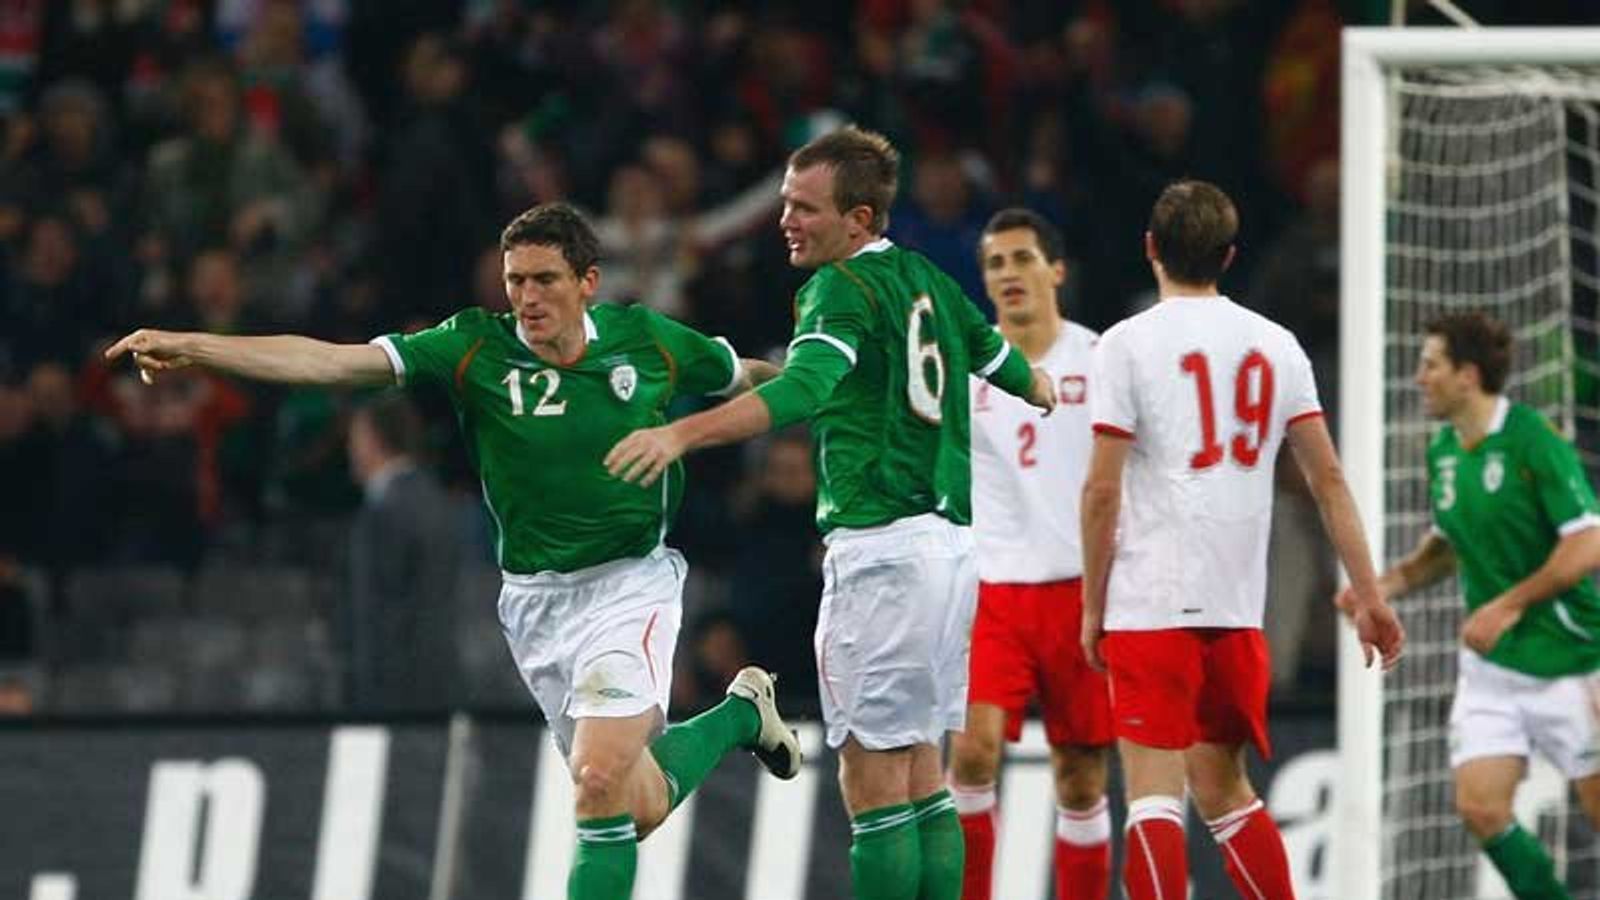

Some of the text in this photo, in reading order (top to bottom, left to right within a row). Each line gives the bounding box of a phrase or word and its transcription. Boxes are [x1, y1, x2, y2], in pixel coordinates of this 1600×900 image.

[501, 368, 567, 417] 12
[908, 294, 945, 425] 6
[1017, 422, 1037, 468] 2
[1179, 350, 1276, 470] 19
